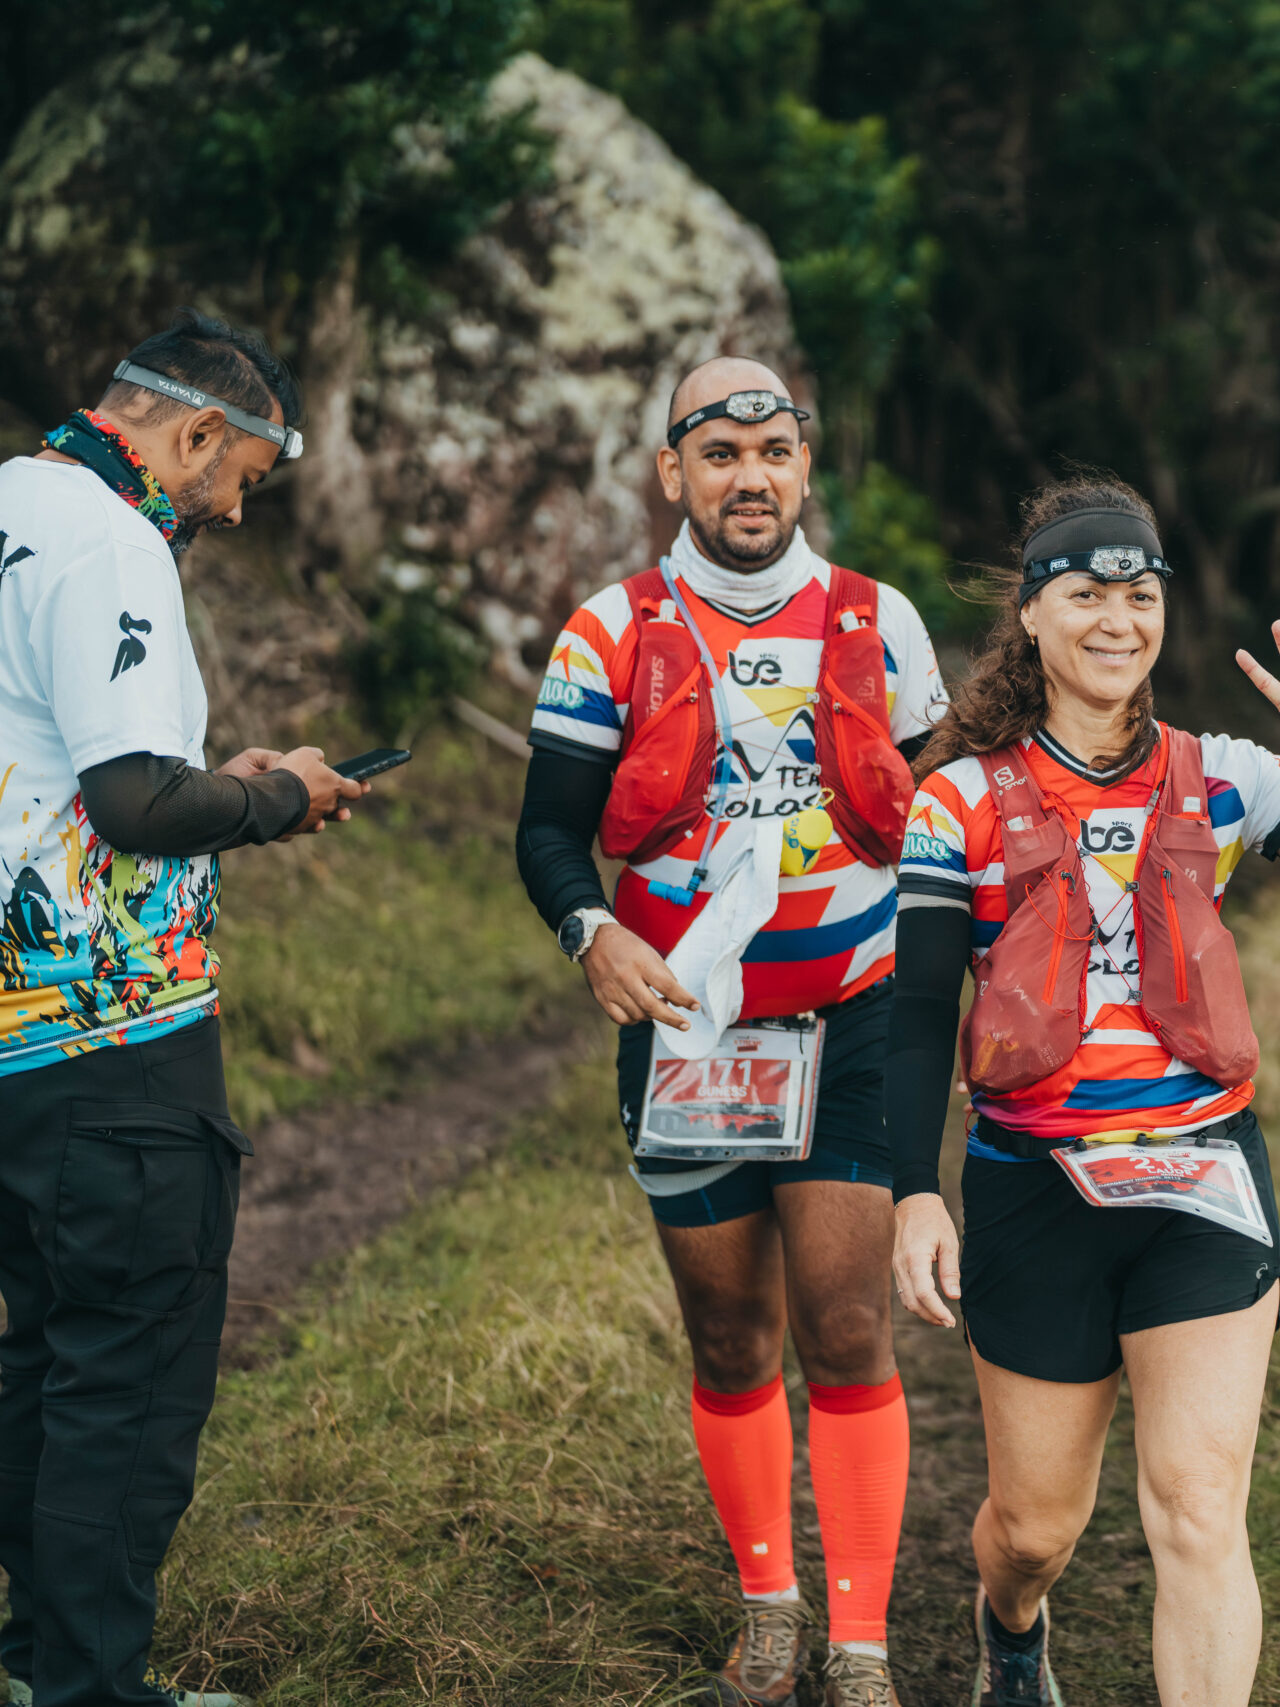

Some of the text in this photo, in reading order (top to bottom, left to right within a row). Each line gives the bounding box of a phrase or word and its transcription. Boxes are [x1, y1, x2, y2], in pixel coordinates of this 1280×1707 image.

[158, 379, 191, 399] VARTA
[1081, 819, 1135, 853] be
[1112, 821, 1132, 829] sport
[697, 1059, 752, 1086] 171
